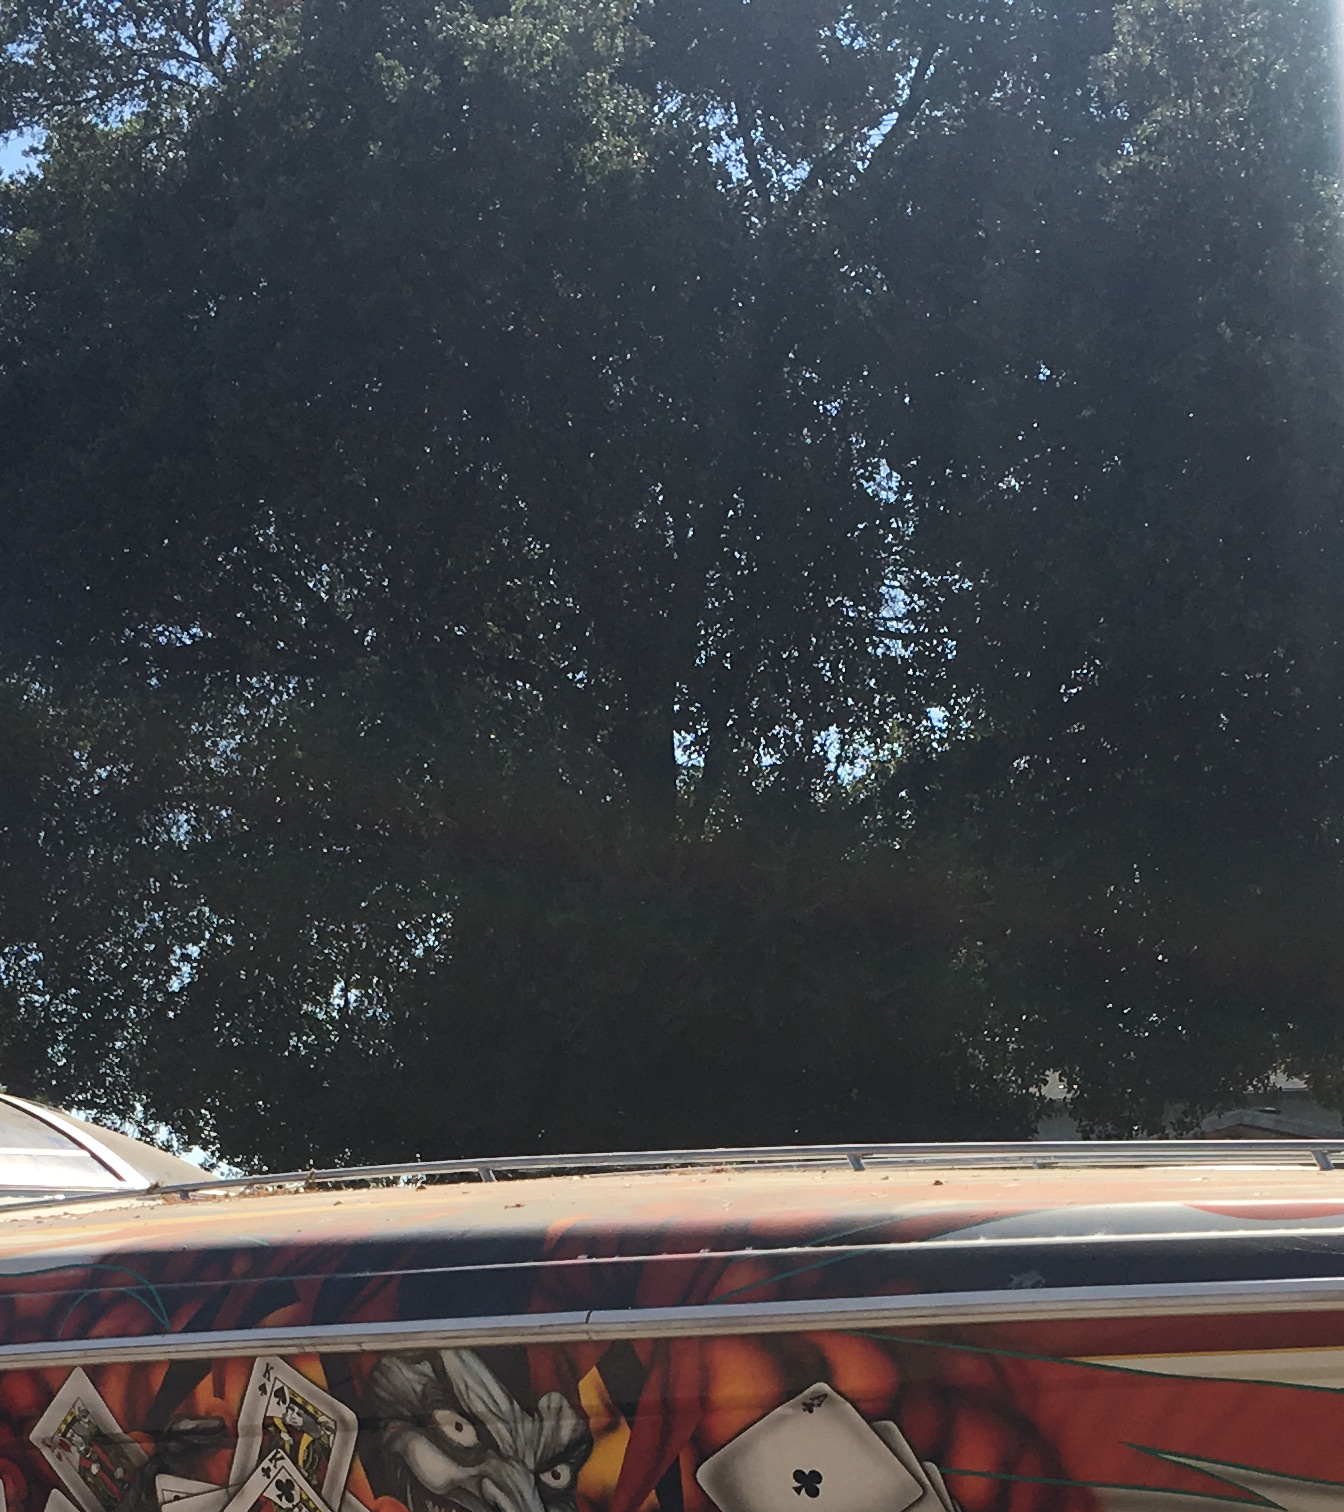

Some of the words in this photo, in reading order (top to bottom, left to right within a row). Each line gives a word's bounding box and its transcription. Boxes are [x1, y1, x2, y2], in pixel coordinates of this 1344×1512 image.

[262, 1362, 274, 1382] K
[809, 1393, 828, 1407] A
[268, 1449, 286, 1469] K
